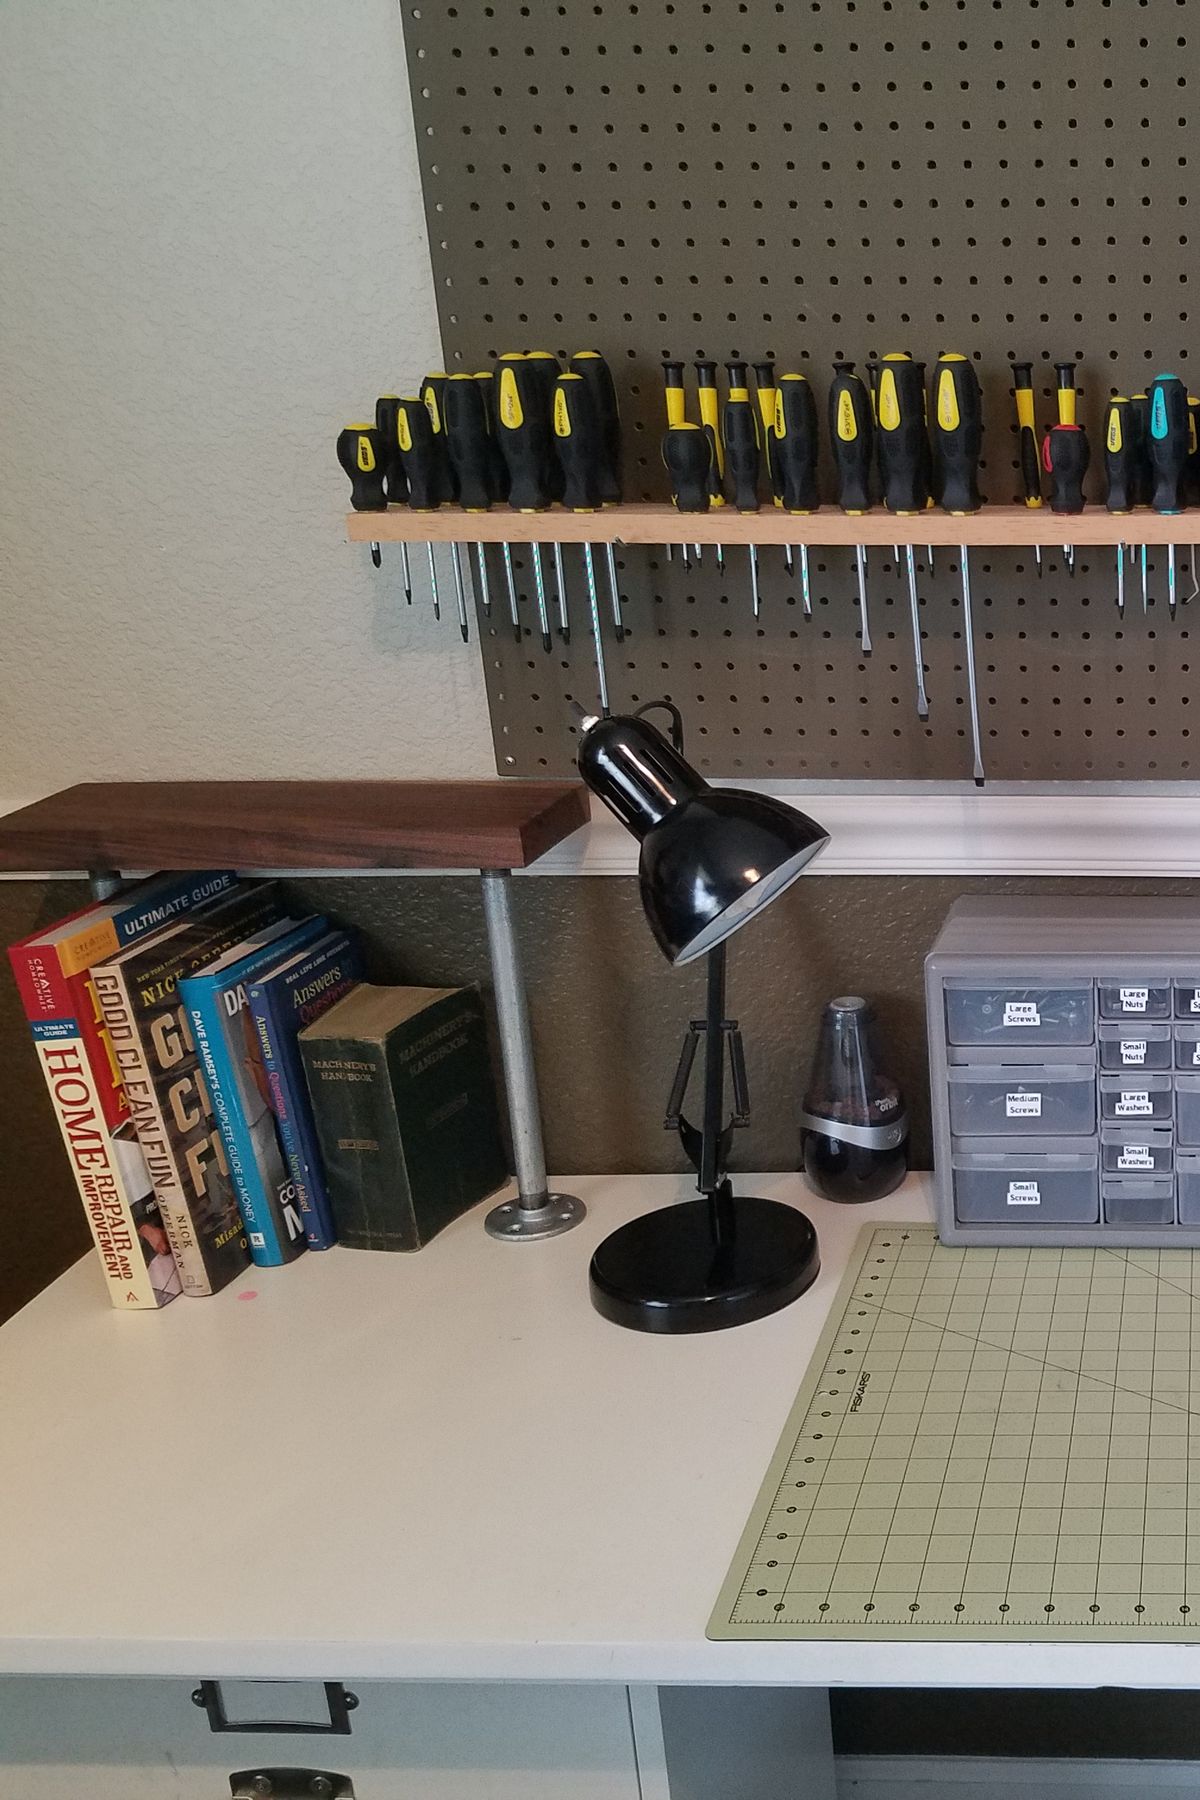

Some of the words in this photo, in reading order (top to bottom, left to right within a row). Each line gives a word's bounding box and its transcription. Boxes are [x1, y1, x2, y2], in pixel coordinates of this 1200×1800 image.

[124, 896, 190, 936] ULTIMATE
[192, 875, 231, 902] GUIDE
[34, 958, 56, 1010] CREATIVE
[293, 966, 342, 1009] Answers
[1123, 989, 1146, 999] Large
[93, 975, 139, 1041] GOOD
[223, 983, 250, 1017] DA
[1009, 1005, 1032, 1014] Large
[1124, 1000, 1144, 1009] Nuts
[34, 1023, 75, 1034] ULTIMATE
[43, 1028, 68, 1036] GUIDE
[191, 1010, 206, 1039] DAVE
[1007, 1015, 1037, 1023] Screws
[255, 1015, 273, 1059] Answers
[1123, 1043, 1145, 1051] Small
[199, 1039, 220, 1090] RAMSEY'S
[312, 1060, 377, 1073] MACHNERY'S
[1124, 1053, 1143, 1062] Nuts
[115, 1049, 160, 1134] CLEAN
[268, 1071, 288, 1121] Questions
[1007, 1095, 1040, 1103] Medium
[1124, 1093, 1147, 1103] Large
[43, 1045, 111, 1171] HOME
[213, 1091, 235, 1144] COMPLETE
[1010, 1106, 1039, 1114] Screws
[1117, 1103, 1151, 1112] Washers
[141, 1140, 176, 1189] FUN
[229, 1144, 244, 1176] GUIDE
[1120, 1157, 1153, 1166] Washers
[1125, 1147, 1148, 1156] Small
[236, 1177, 244, 1189] to
[289, 1153, 302, 1183] Never
[295, 1183, 312, 1213] Asked
[1010, 1194, 1039, 1202] Screws
[1013, 1183, 1036, 1191] Small
[239, 1187, 257, 1223] MONEY
[80, 1174, 123, 1281] IMPROVEMENT
[95, 1173, 133, 1252] REPAIR
[117, 1255, 133, 1280] AND
[176, 1215, 193, 1249] NICK
[850, 1371, 871, 1413] FISKARS
